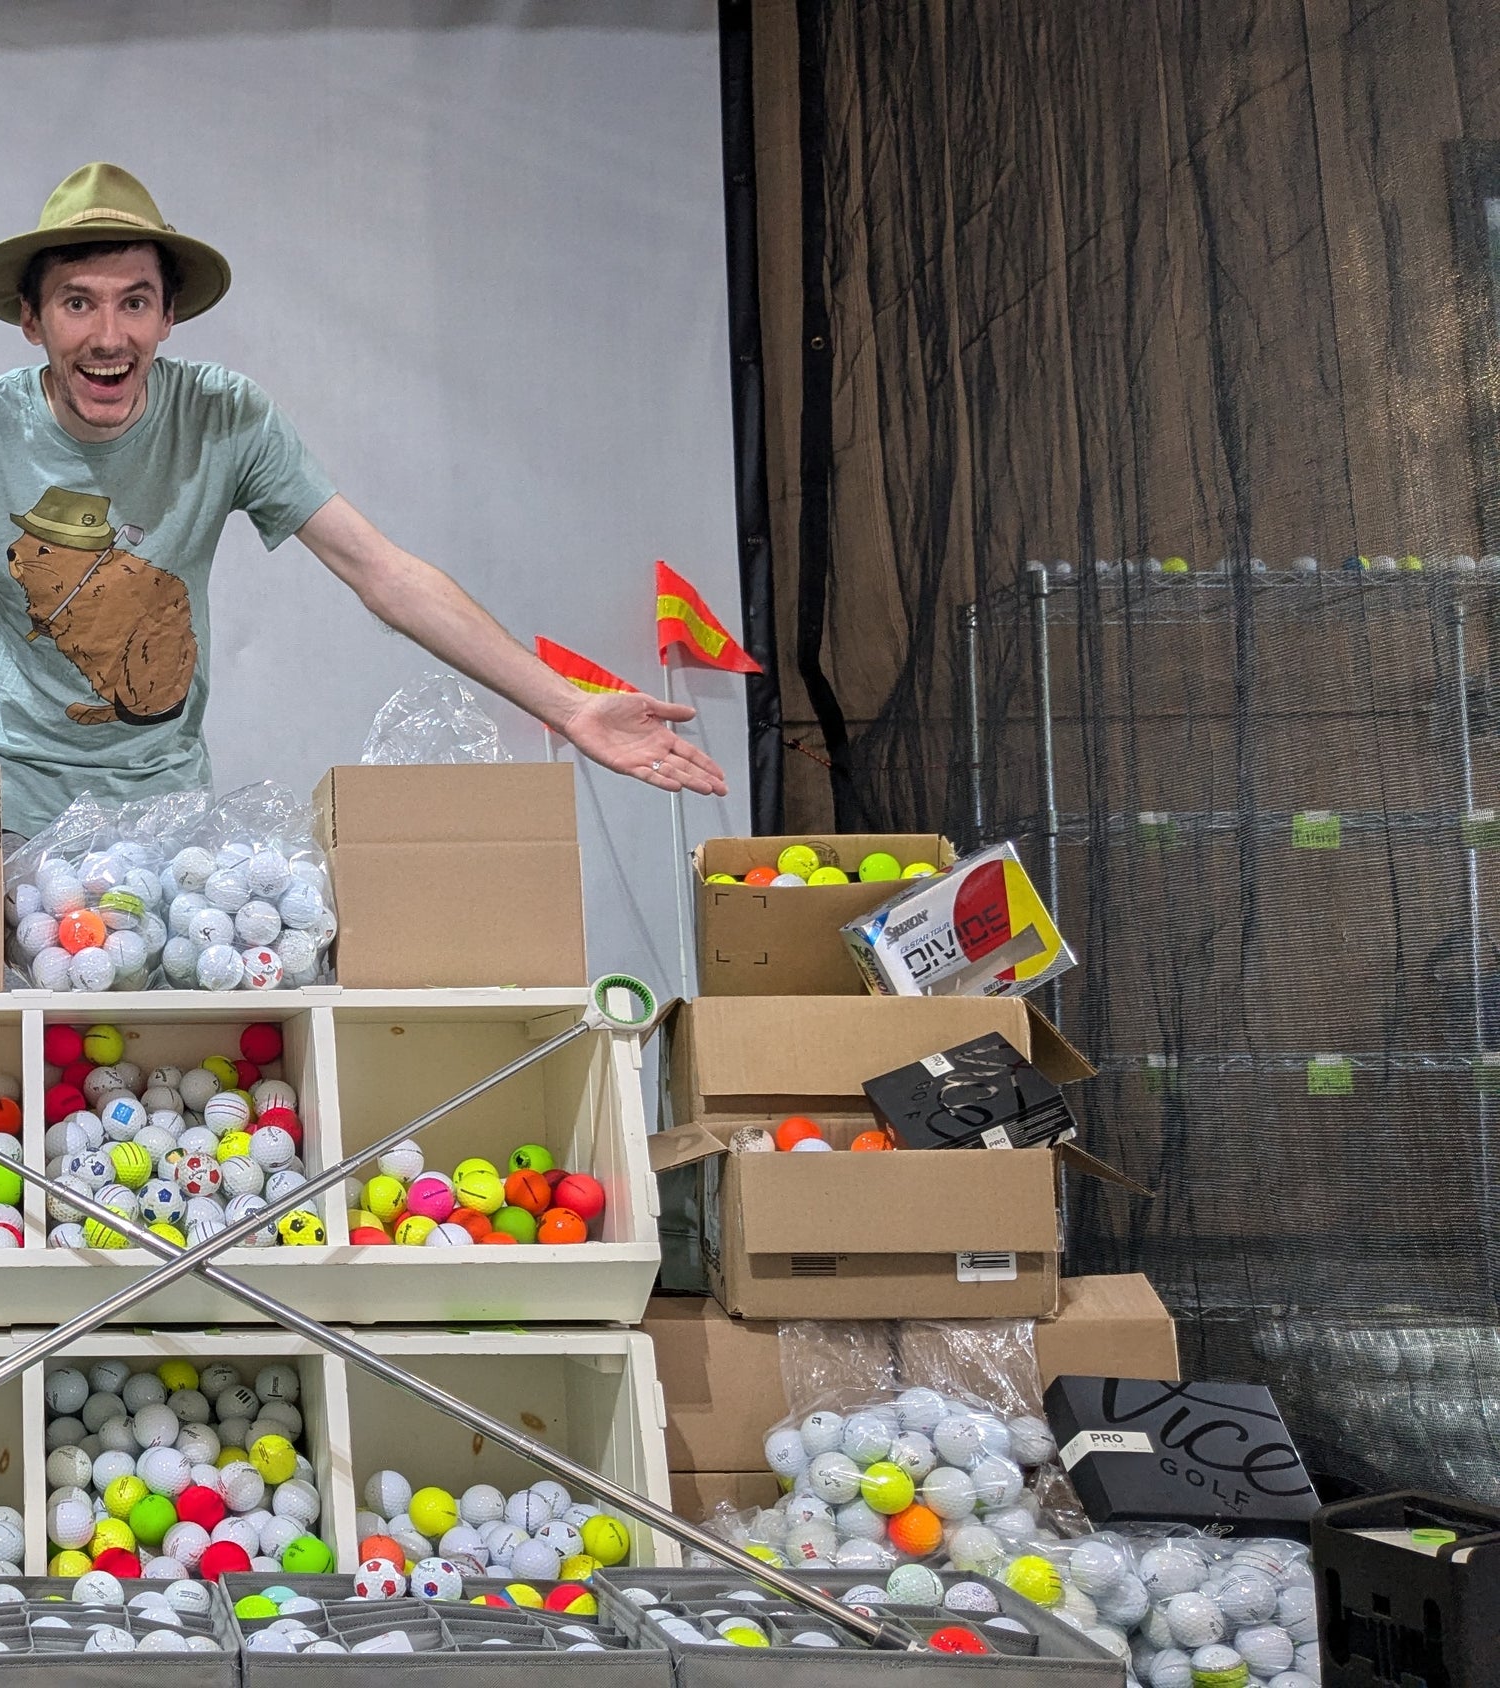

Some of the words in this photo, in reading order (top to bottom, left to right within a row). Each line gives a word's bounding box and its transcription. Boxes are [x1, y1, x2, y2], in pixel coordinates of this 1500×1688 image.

[884, 909, 929, 944] SRIXON
[903, 903, 1010, 979] DIVIDE
[930, 921, 950, 937] TOUR
[983, 978, 1005, 994] BRITE
[904, 1080, 935, 1119] GOF
[989, 1138, 1007, 1147] PRO
[1090, 1433, 1124, 1443] PRO
[1102, 1377, 1314, 1497] Vice
[1160, 1457, 1251, 1506] GOLF
